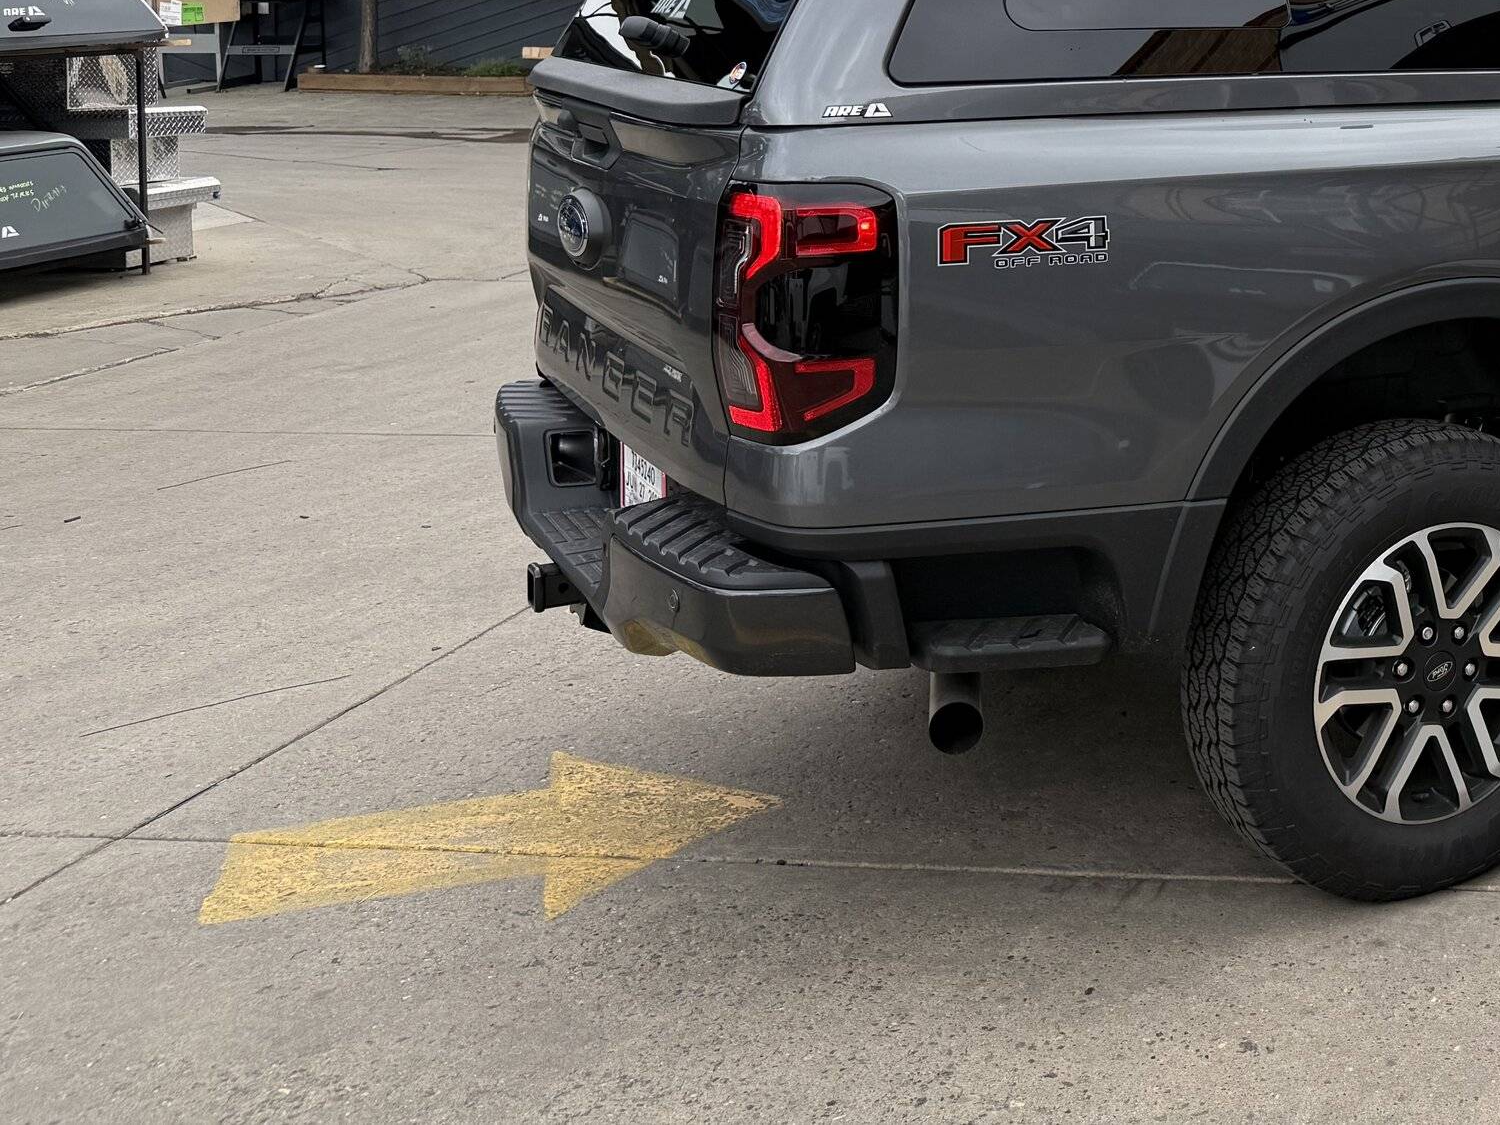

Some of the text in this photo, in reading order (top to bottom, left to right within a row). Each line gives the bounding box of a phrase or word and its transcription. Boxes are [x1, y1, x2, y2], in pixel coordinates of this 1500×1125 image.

[822, 105, 864, 118] ARE
[937, 215, 1110, 267] FX4
[993, 251, 1109, 270] OFF ROAD
[539, 301, 695, 448] RANGER
